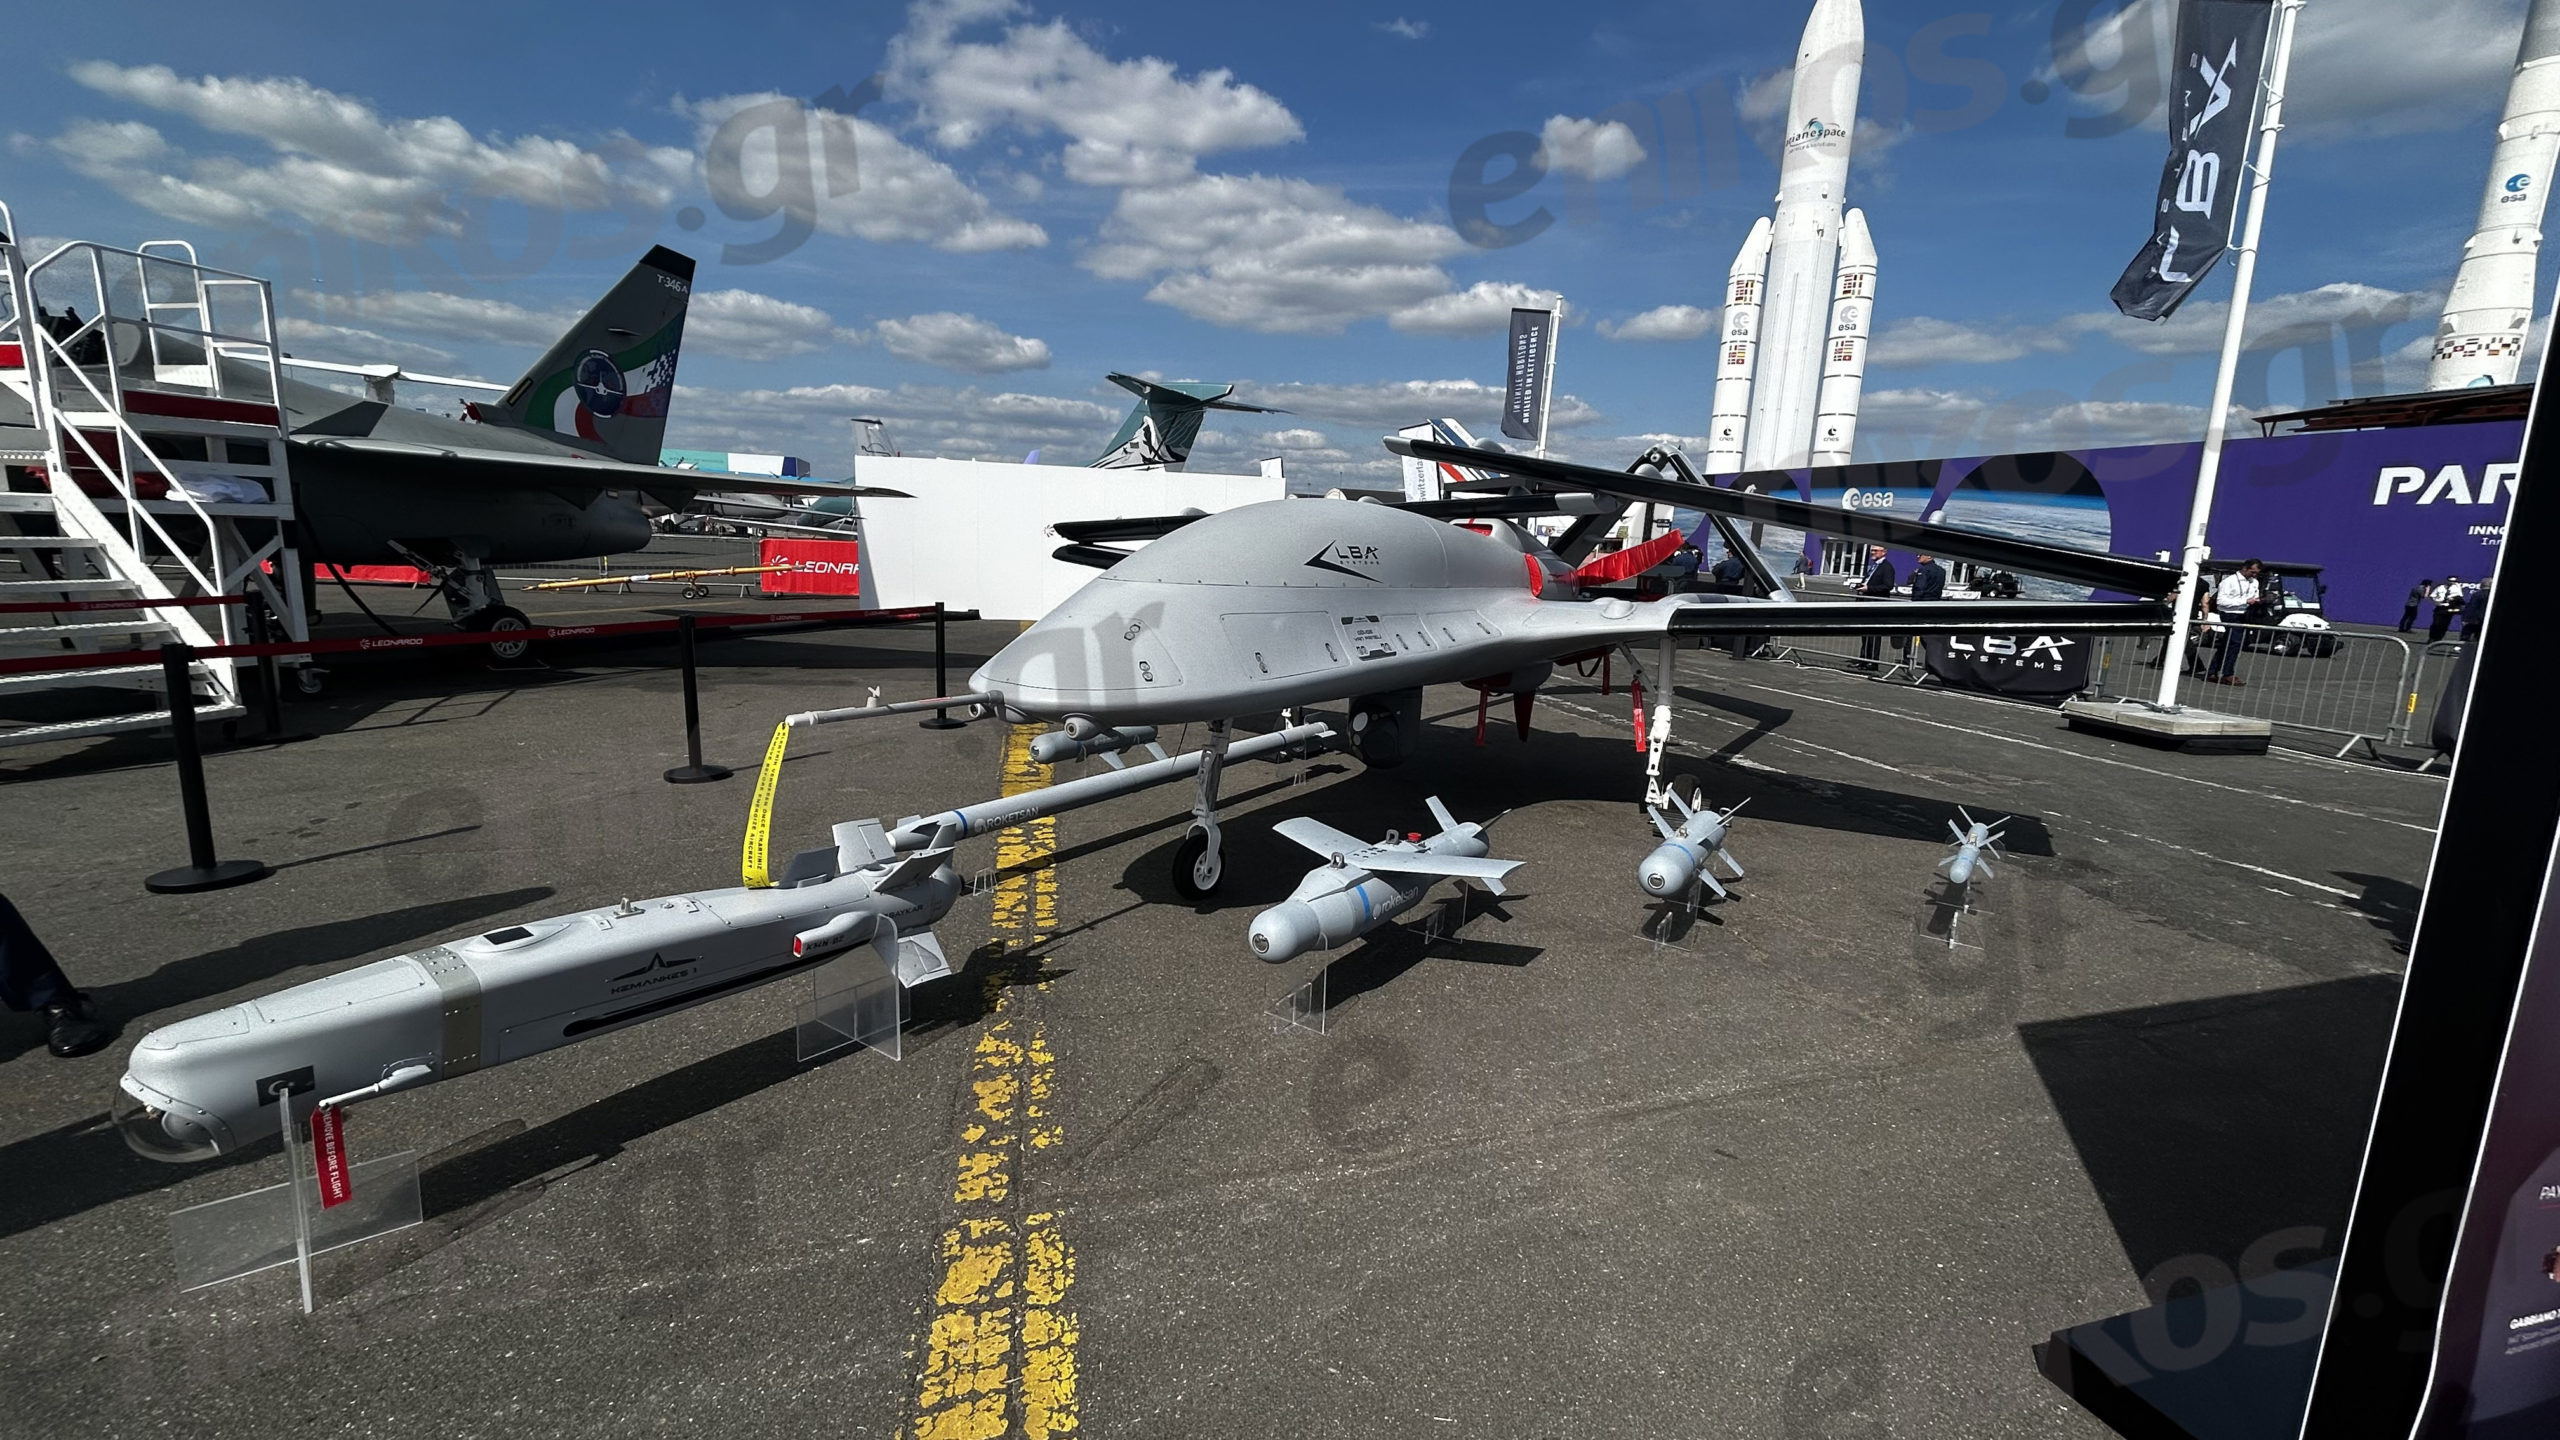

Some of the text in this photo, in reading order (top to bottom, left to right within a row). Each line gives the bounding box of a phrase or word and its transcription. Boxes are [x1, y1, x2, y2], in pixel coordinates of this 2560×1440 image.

[1731, 328, 1748, 336] esa
[1838, 323, 1857, 331] esa
[1861, 491, 1894, 508] esa
[1335, 546, 1379, 559] LBA
[556, 627, 596, 636] LEONARDO
[372, 637, 424, 647] LEONARDO
[1948, 652, 2063, 672] SYSTEMS
[986, 806, 1040, 829] ROKETSAN
[325, 1142, 338, 1171] BEFORE
[330, 1171, 343, 1198] FLIGHT
